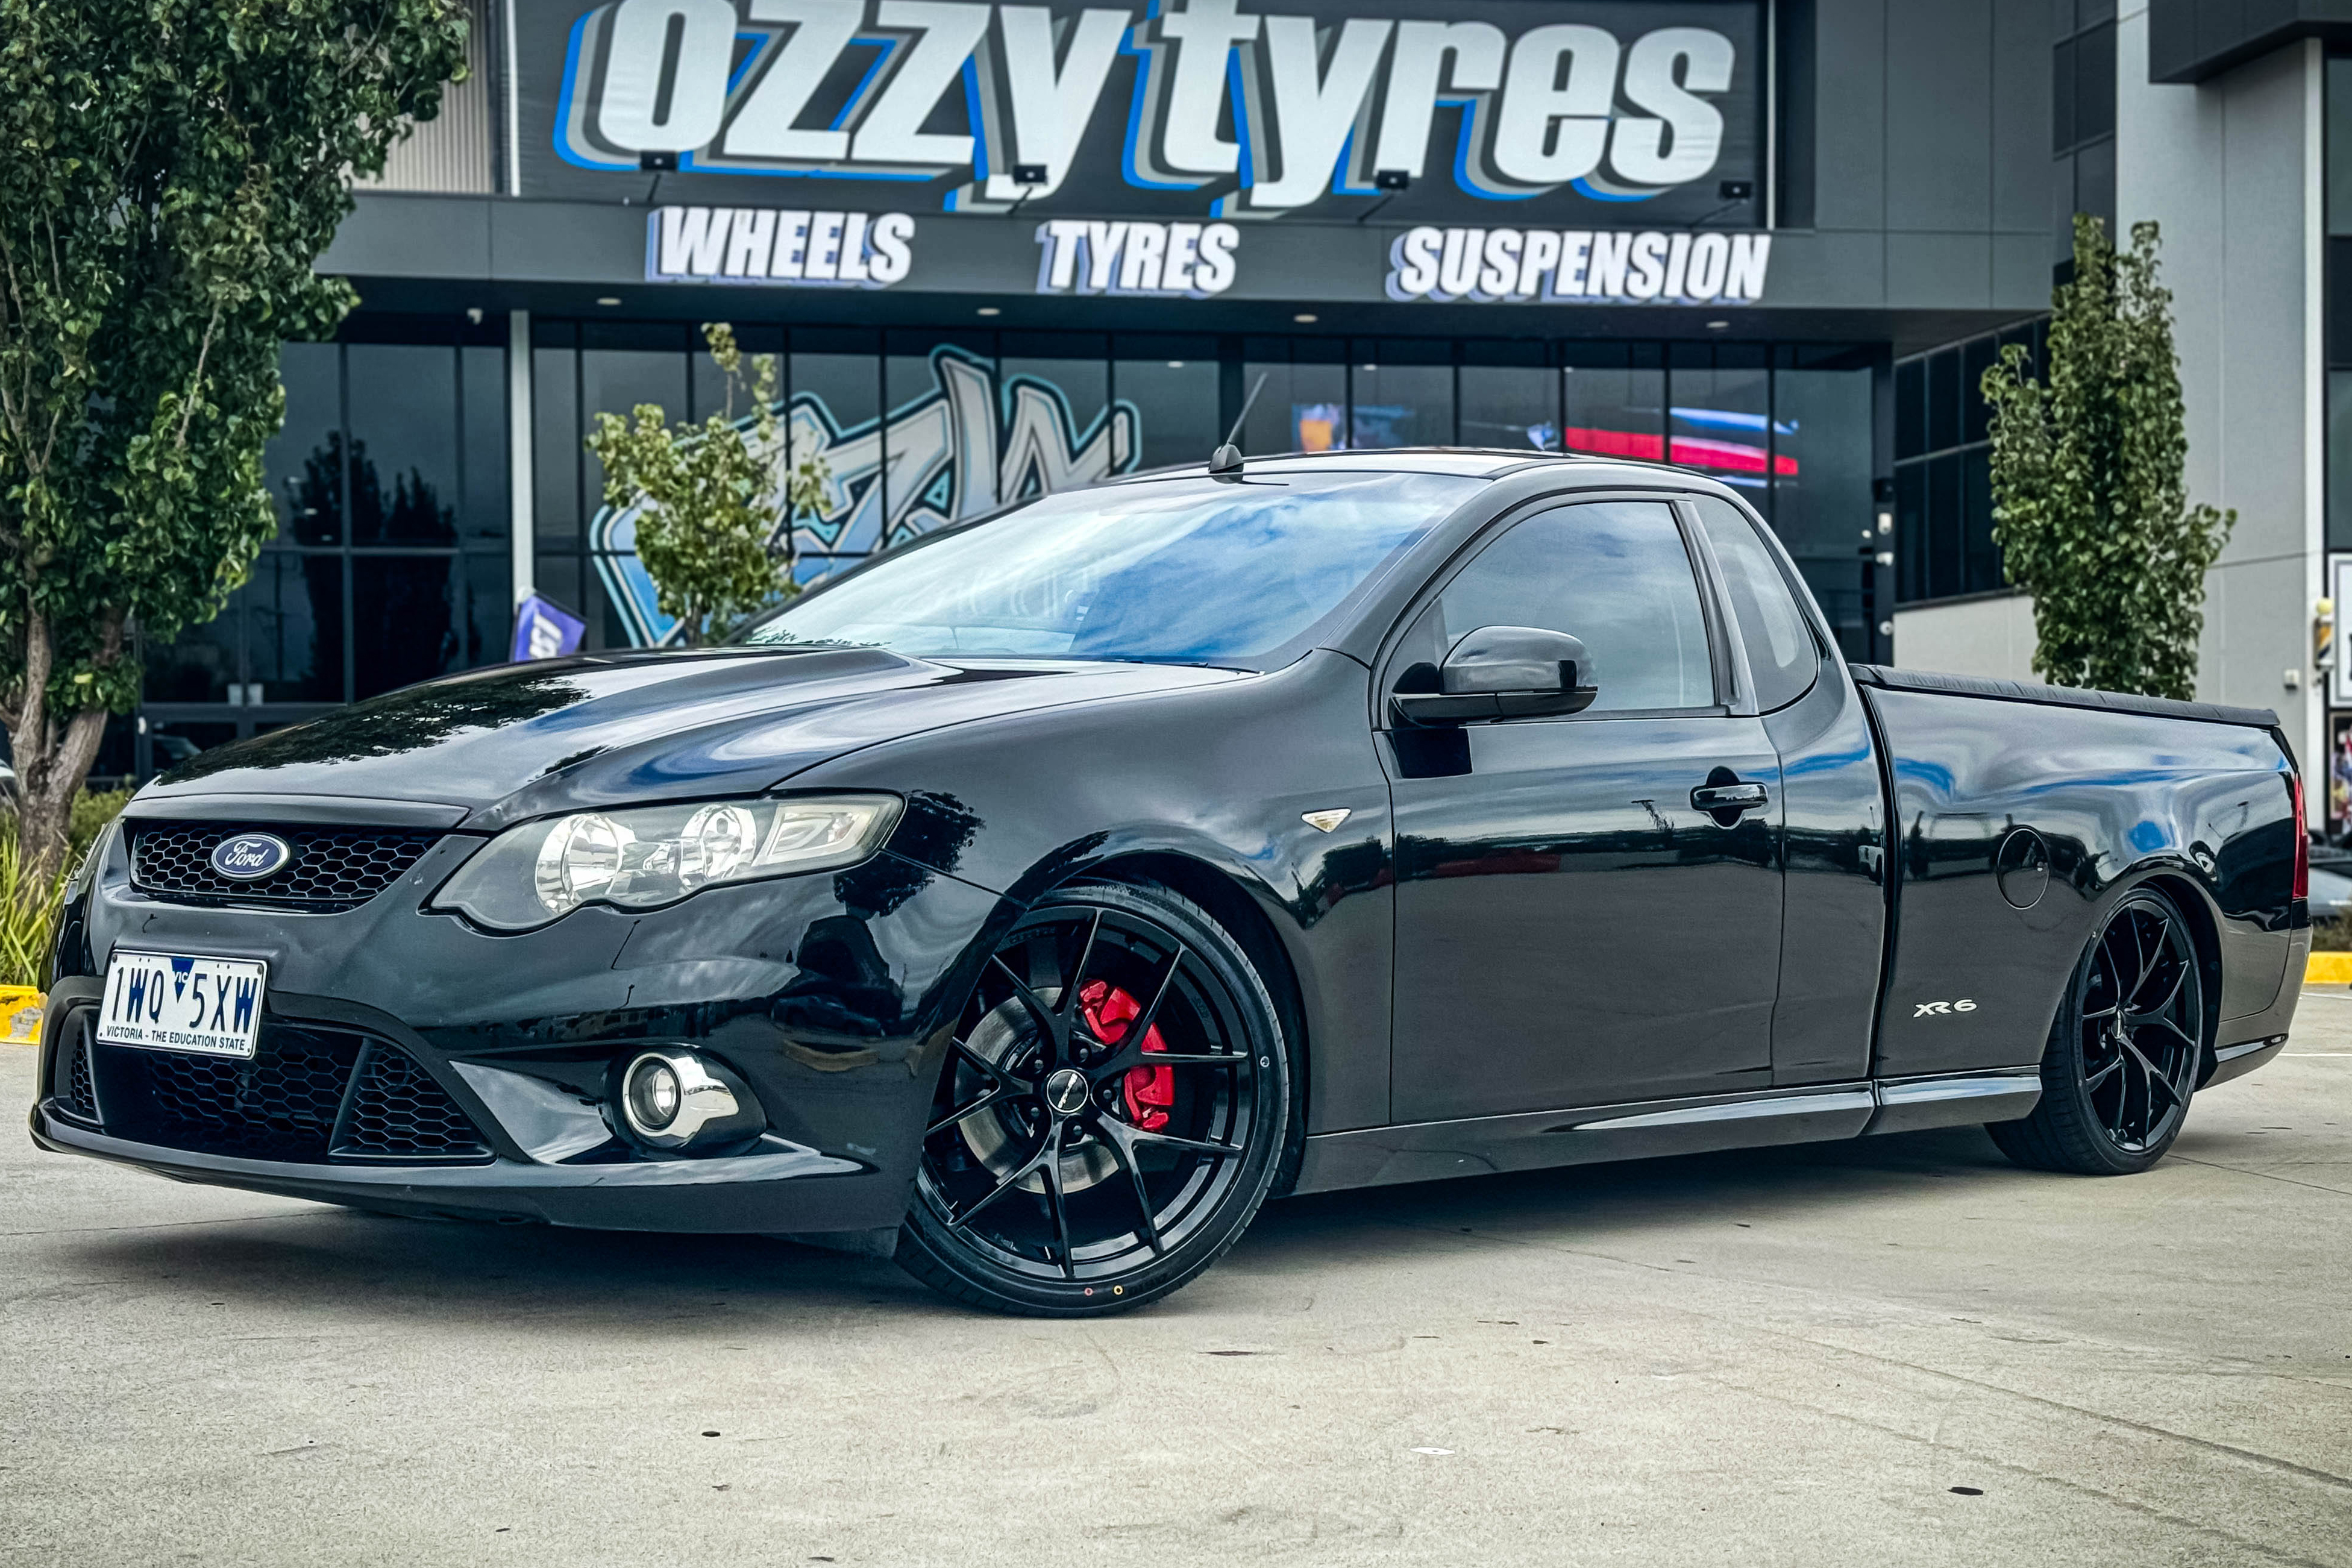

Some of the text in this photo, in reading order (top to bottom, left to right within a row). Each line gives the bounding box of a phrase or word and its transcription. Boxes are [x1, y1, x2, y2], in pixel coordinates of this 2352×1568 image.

[657, 206, 1772, 300] WHEELS TYRES SUSPENSION
[224, 840, 270, 867] Ford
[111, 966, 258, 1034] 1WQ 5XW
[1912, 999, 1977, 1018] XR6
[106, 1025, 143, 1040] VICTORIA
[151, 1030, 167, 1043] THE
[169, 1032, 217, 1048] EDUCATION
[219, 1037, 246, 1051] STATE
